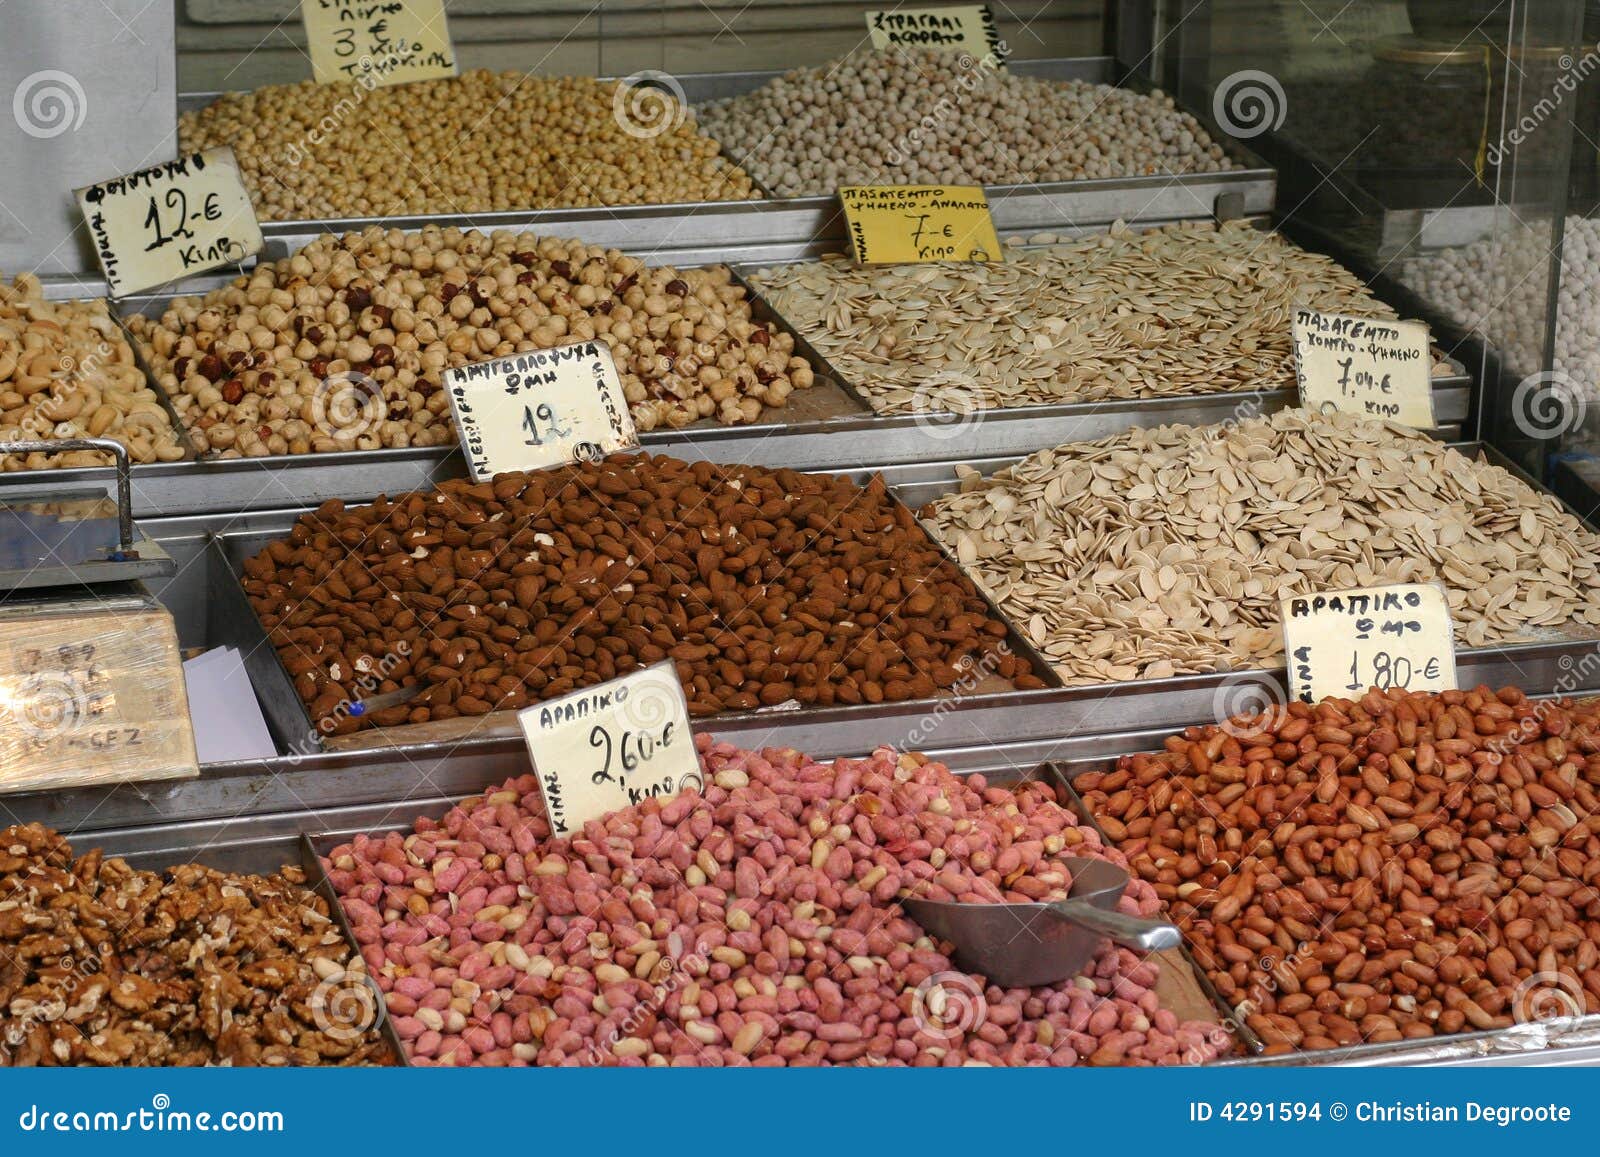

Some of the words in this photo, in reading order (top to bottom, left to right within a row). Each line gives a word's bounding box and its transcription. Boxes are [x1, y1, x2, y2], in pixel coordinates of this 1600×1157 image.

[332, 28, 356, 57] 3
[1292, 592, 1421, 617] ΑΡΑΠΙΚΟ
[540, 685, 629, 729] ΑΡΑΠΙΚΟ
